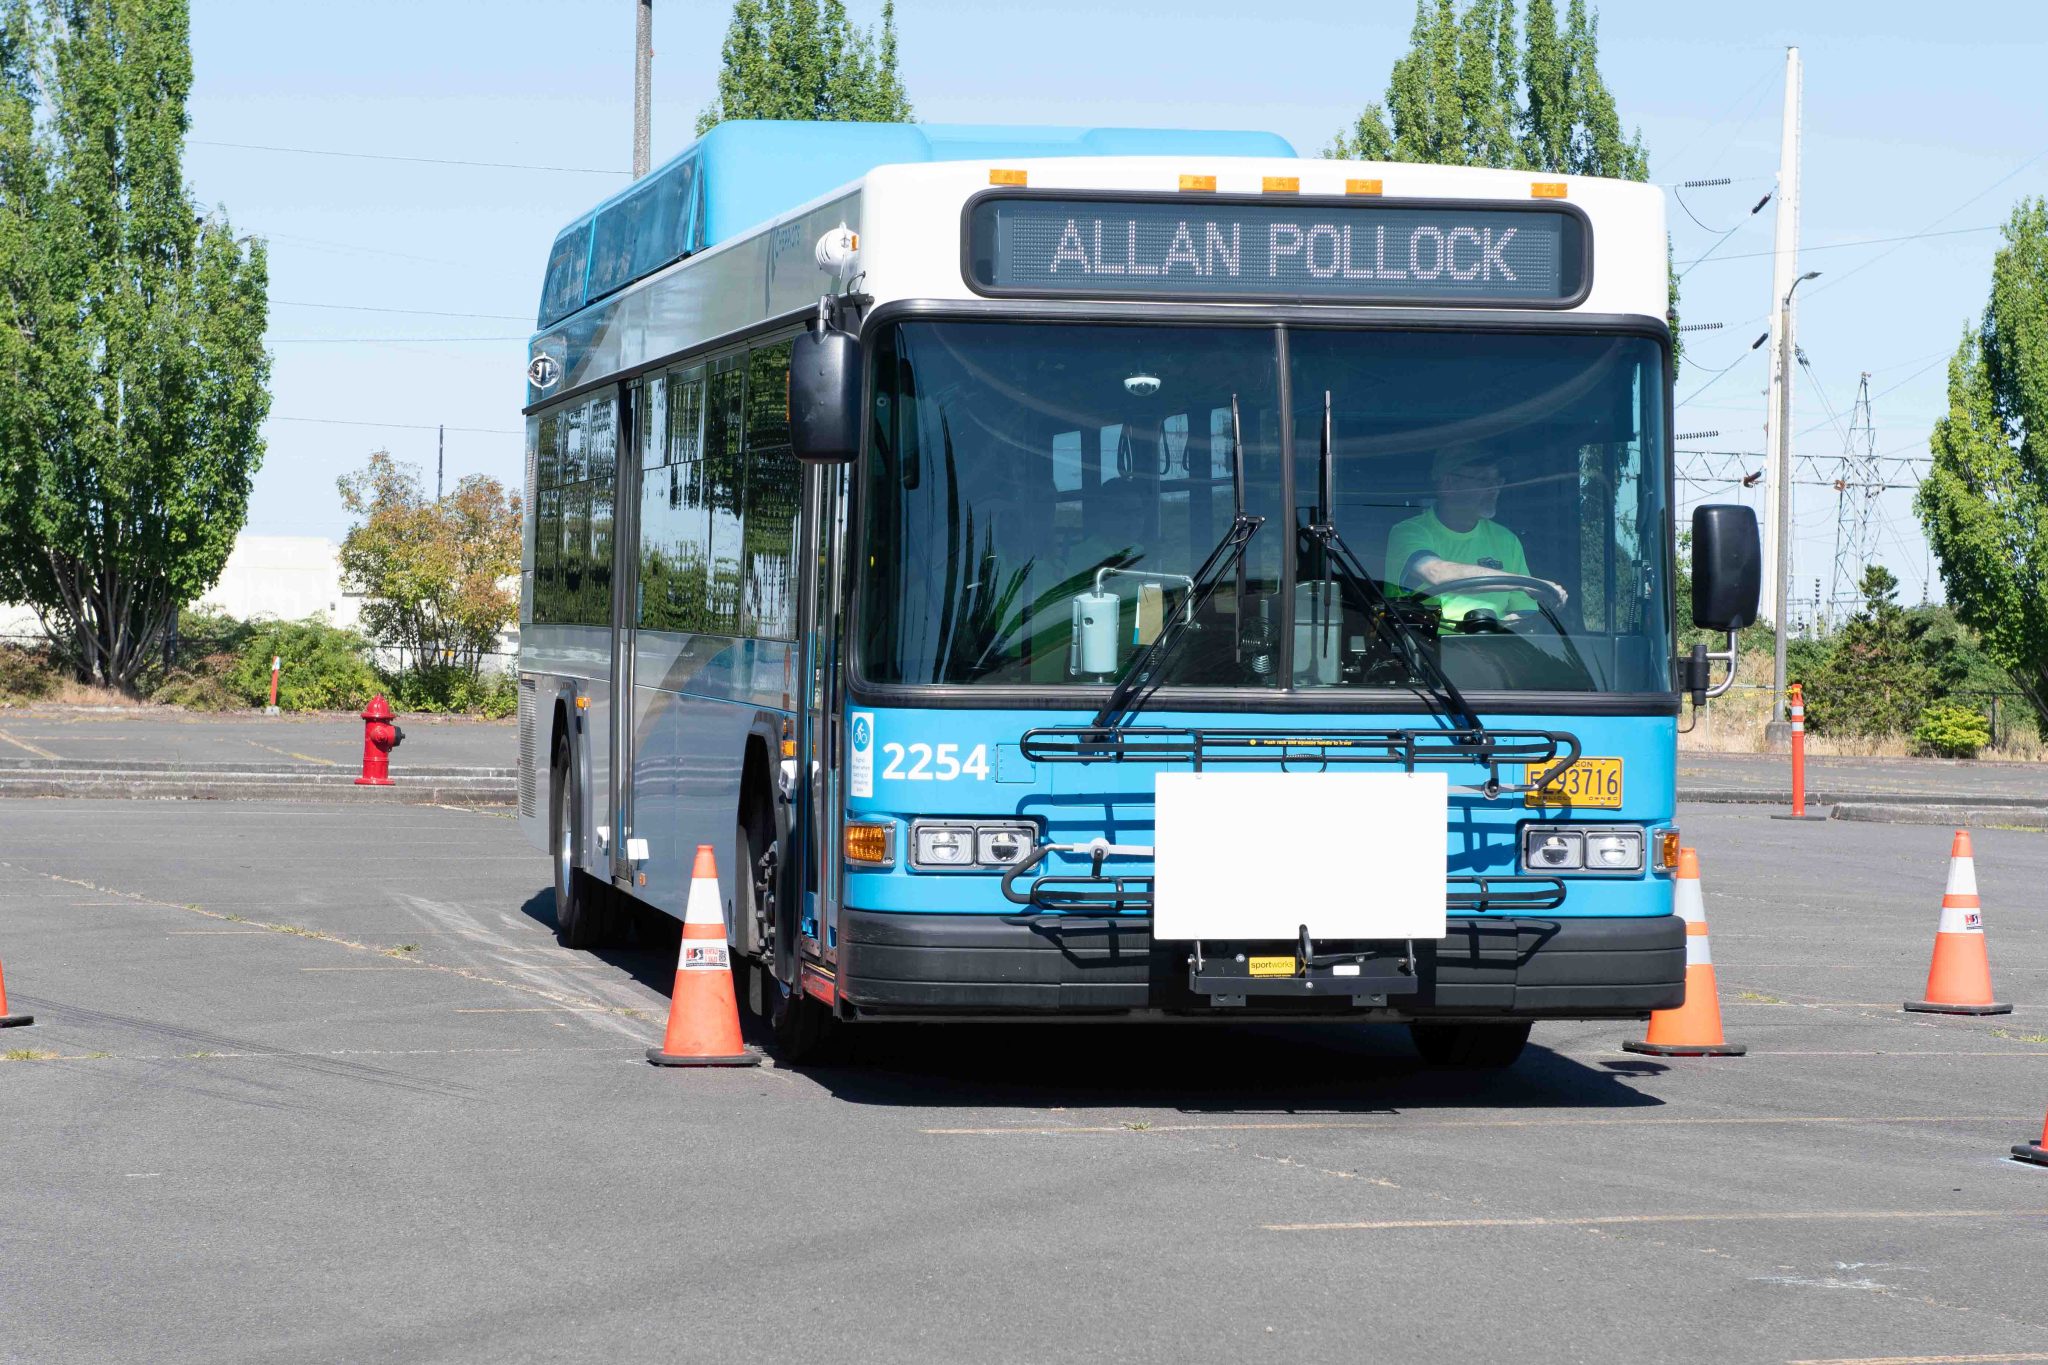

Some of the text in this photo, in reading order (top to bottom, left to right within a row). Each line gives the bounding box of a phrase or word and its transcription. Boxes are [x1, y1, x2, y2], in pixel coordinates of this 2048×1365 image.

[1050, 218, 1518, 282] ALLAN POLLOCK
[882, 742, 990, 781] 2254
[1556, 760, 1593, 768] GON
[1251, 961, 1294, 970] sportworks
